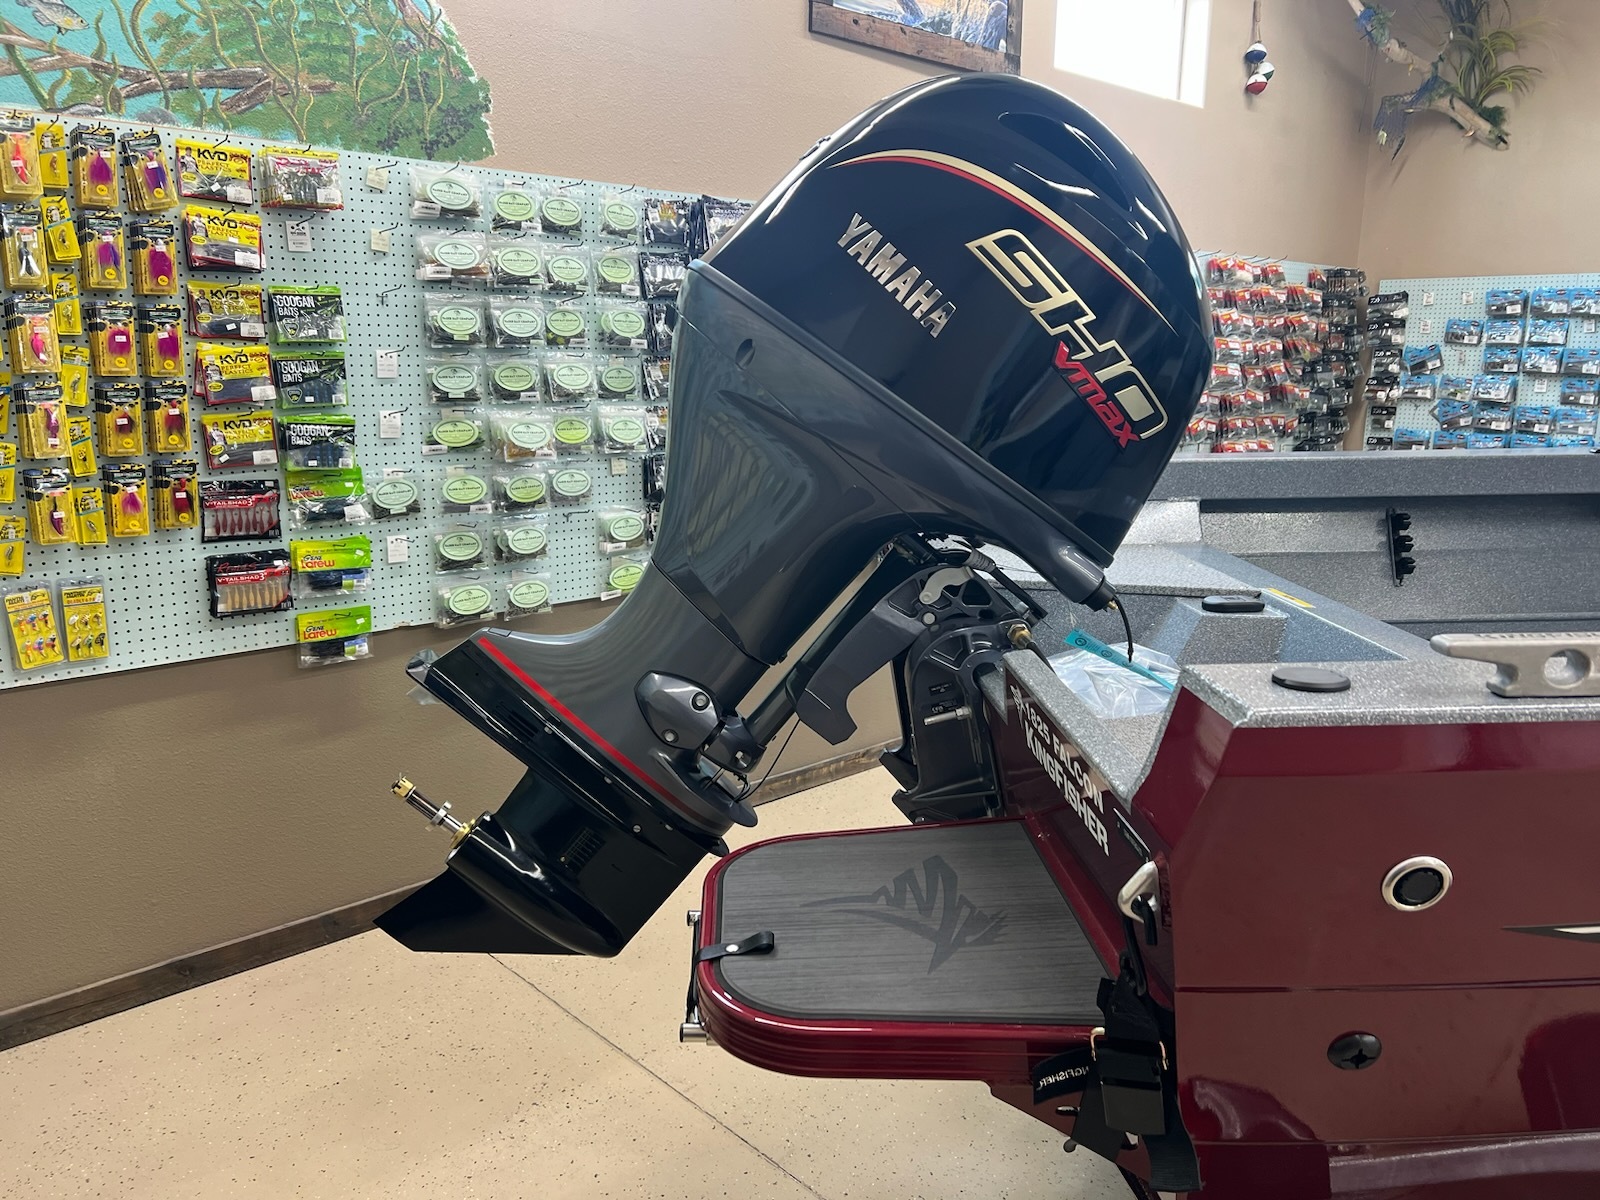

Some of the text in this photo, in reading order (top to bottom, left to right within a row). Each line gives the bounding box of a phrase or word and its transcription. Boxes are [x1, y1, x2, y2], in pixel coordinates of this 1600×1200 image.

[198, 148, 228, 162] KVD
[208, 215, 238, 228] KVD
[837, 212, 957, 338] YAMAHA
[277, 295, 315, 308] GOOGAN
[278, 308, 299, 316] BAITS
[220, 354, 248, 364] KVD
[282, 360, 319, 373] GOOGAN
[282, 373, 302, 382] BAITS
[224, 419, 252, 430] KVD
[290, 424, 330, 436] GOOGAN
[292, 436, 312, 445] BAITS
[301, 560, 335, 568] Larew
[304, 629, 337, 640] Larew
[1025, 702, 1104, 814] 1825 FALCON
[1024, 721, 1109, 856] KINGFISHER
